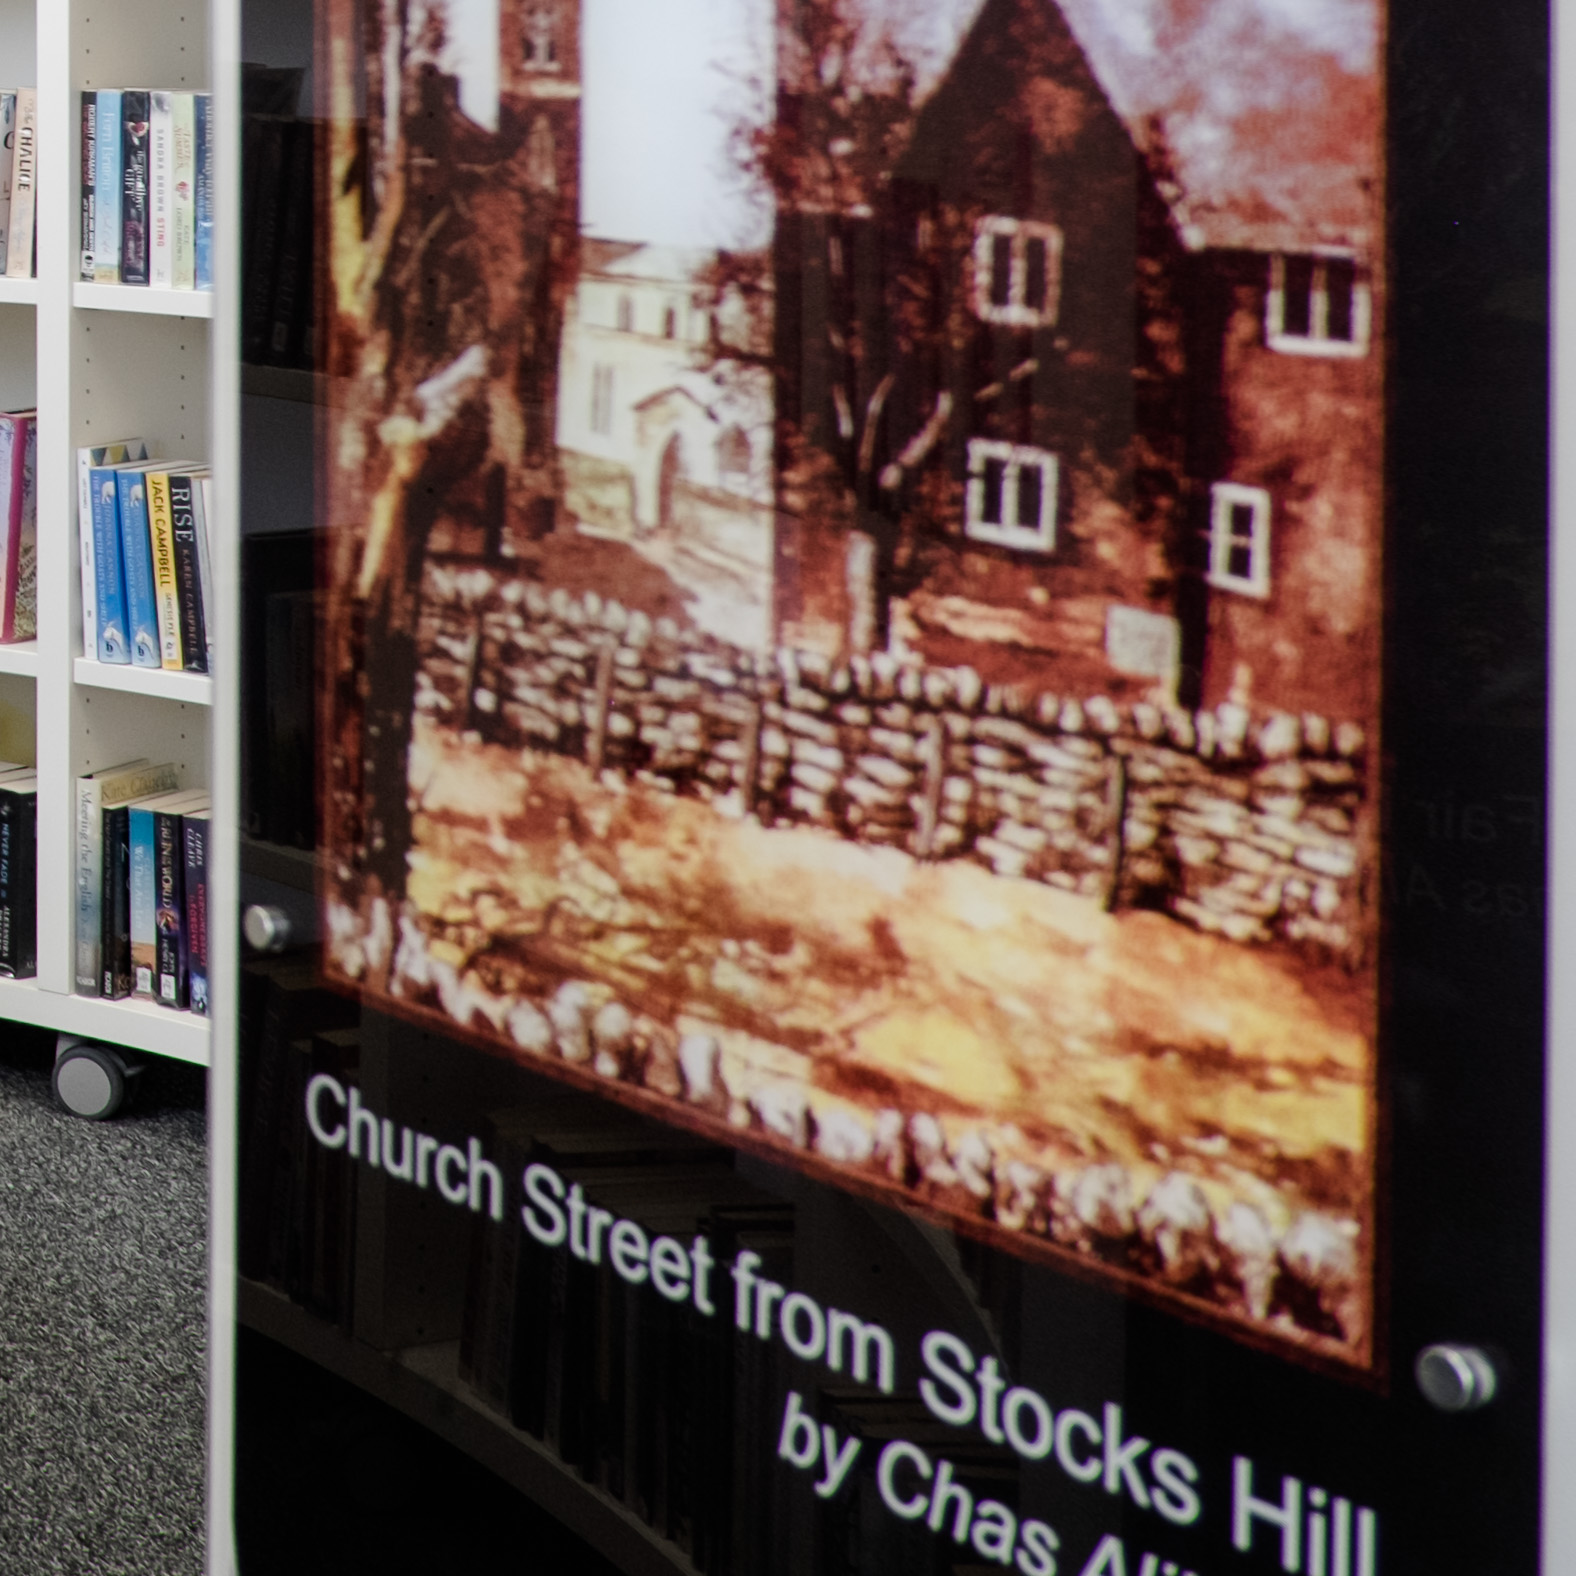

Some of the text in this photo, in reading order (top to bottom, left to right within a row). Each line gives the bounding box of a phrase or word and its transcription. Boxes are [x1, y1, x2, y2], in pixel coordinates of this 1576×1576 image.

[18, 126, 34, 192] CHALICE
[101, 111, 115, 191] Fern Britton
[156, 128, 165, 247] SANDRA BROWN STING
[151, 479, 170, 587] JACK CAMPBELL
[171, 487, 198, 655] RISE KAREN CAMPBELL
[0, 823, 9, 884] NEVER FADE
[79, 789, 92, 911] Meeting the English
[161, 866, 172, 908] WORLD
[186, 828, 197, 869] CLEAVE
[2, 905, 11, 957] ALEXANDRA
[189, 903, 199, 953] FORGIVEN
[303, 1072, 1377, 1576] Church Street from Stocks Hill
[777, 1390, 1062, 1576] by Chas
